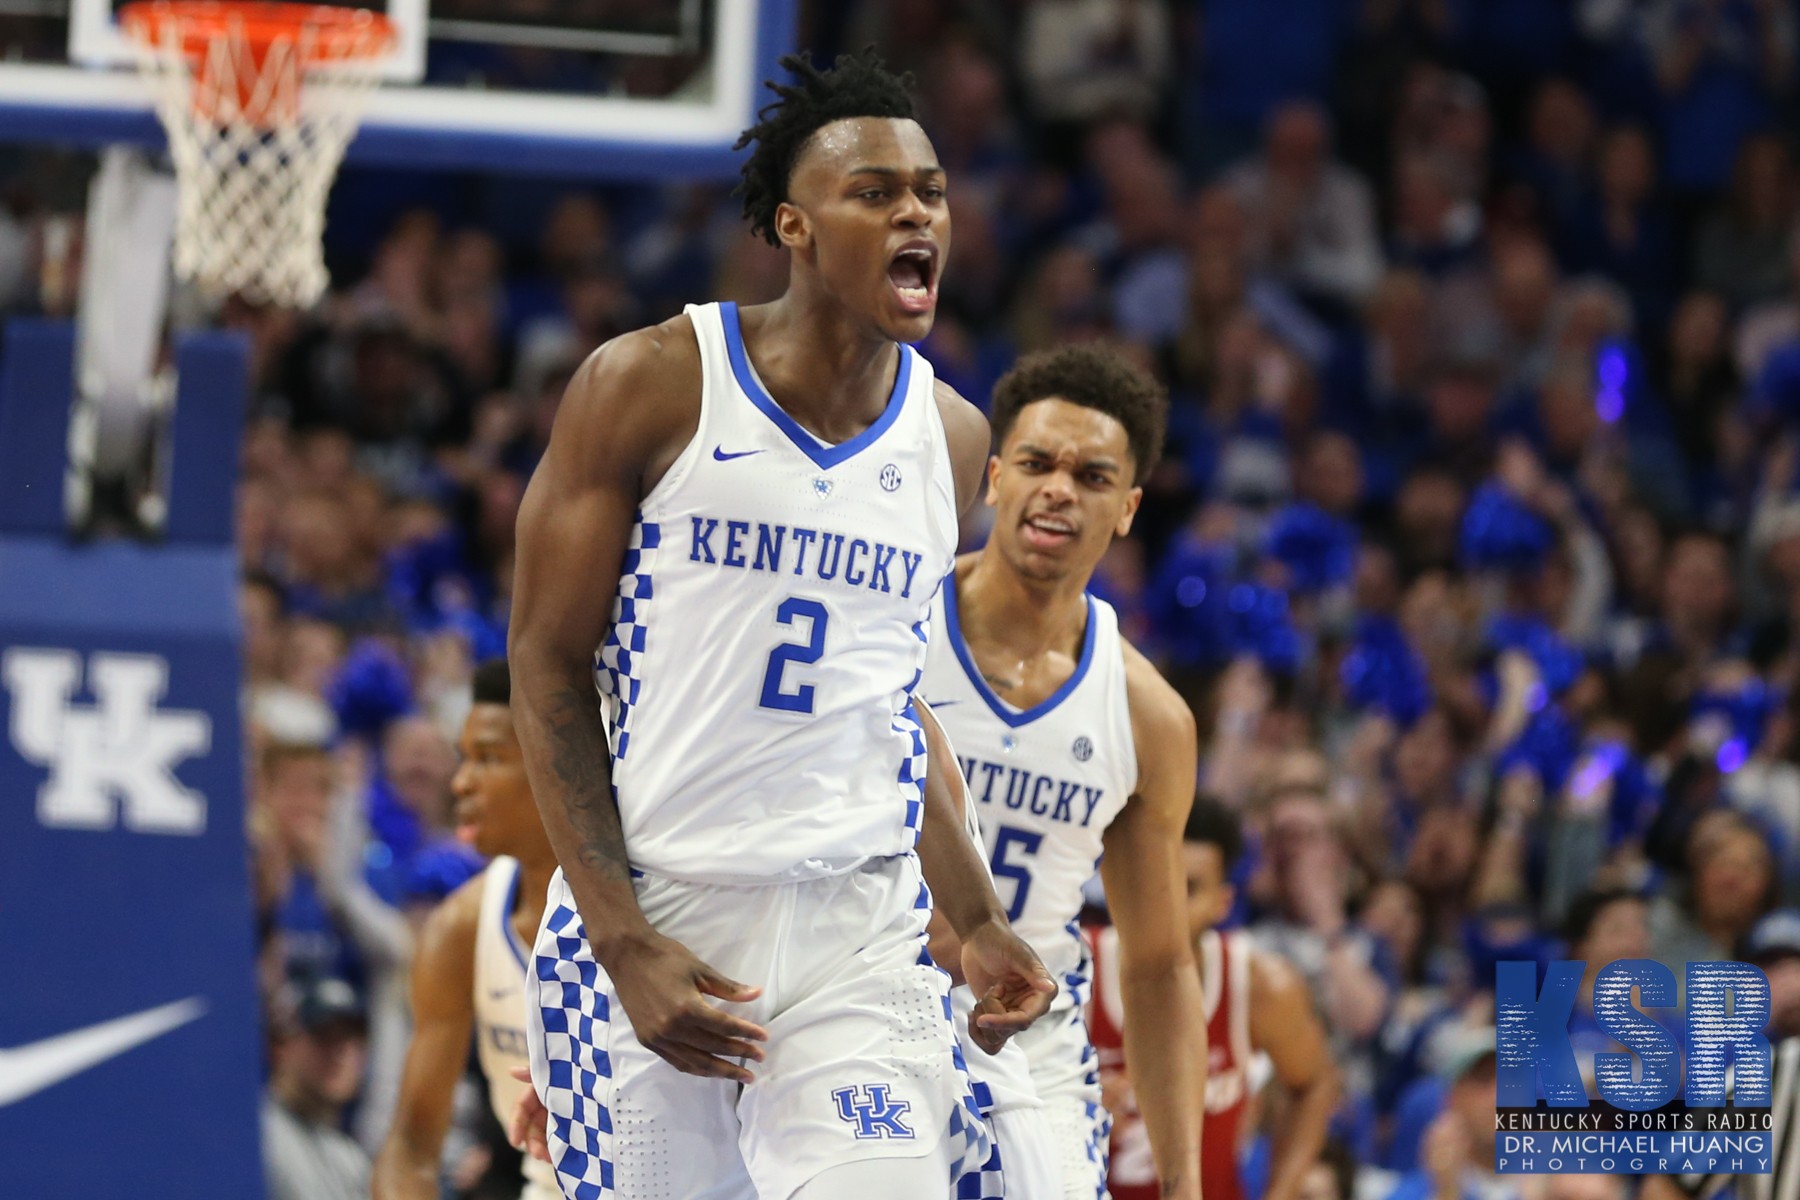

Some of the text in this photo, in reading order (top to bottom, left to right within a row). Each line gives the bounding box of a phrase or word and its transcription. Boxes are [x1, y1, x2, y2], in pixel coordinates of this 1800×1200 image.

[689, 516, 922, 598] KENTUCKY
[758, 596, 829, 714] 2
[3, 647, 212, 835] UK
[957, 755, 1104, 827] NTUCKY
[979, 824, 1045, 923] 5
[831, 1083, 916, 1140] UK
